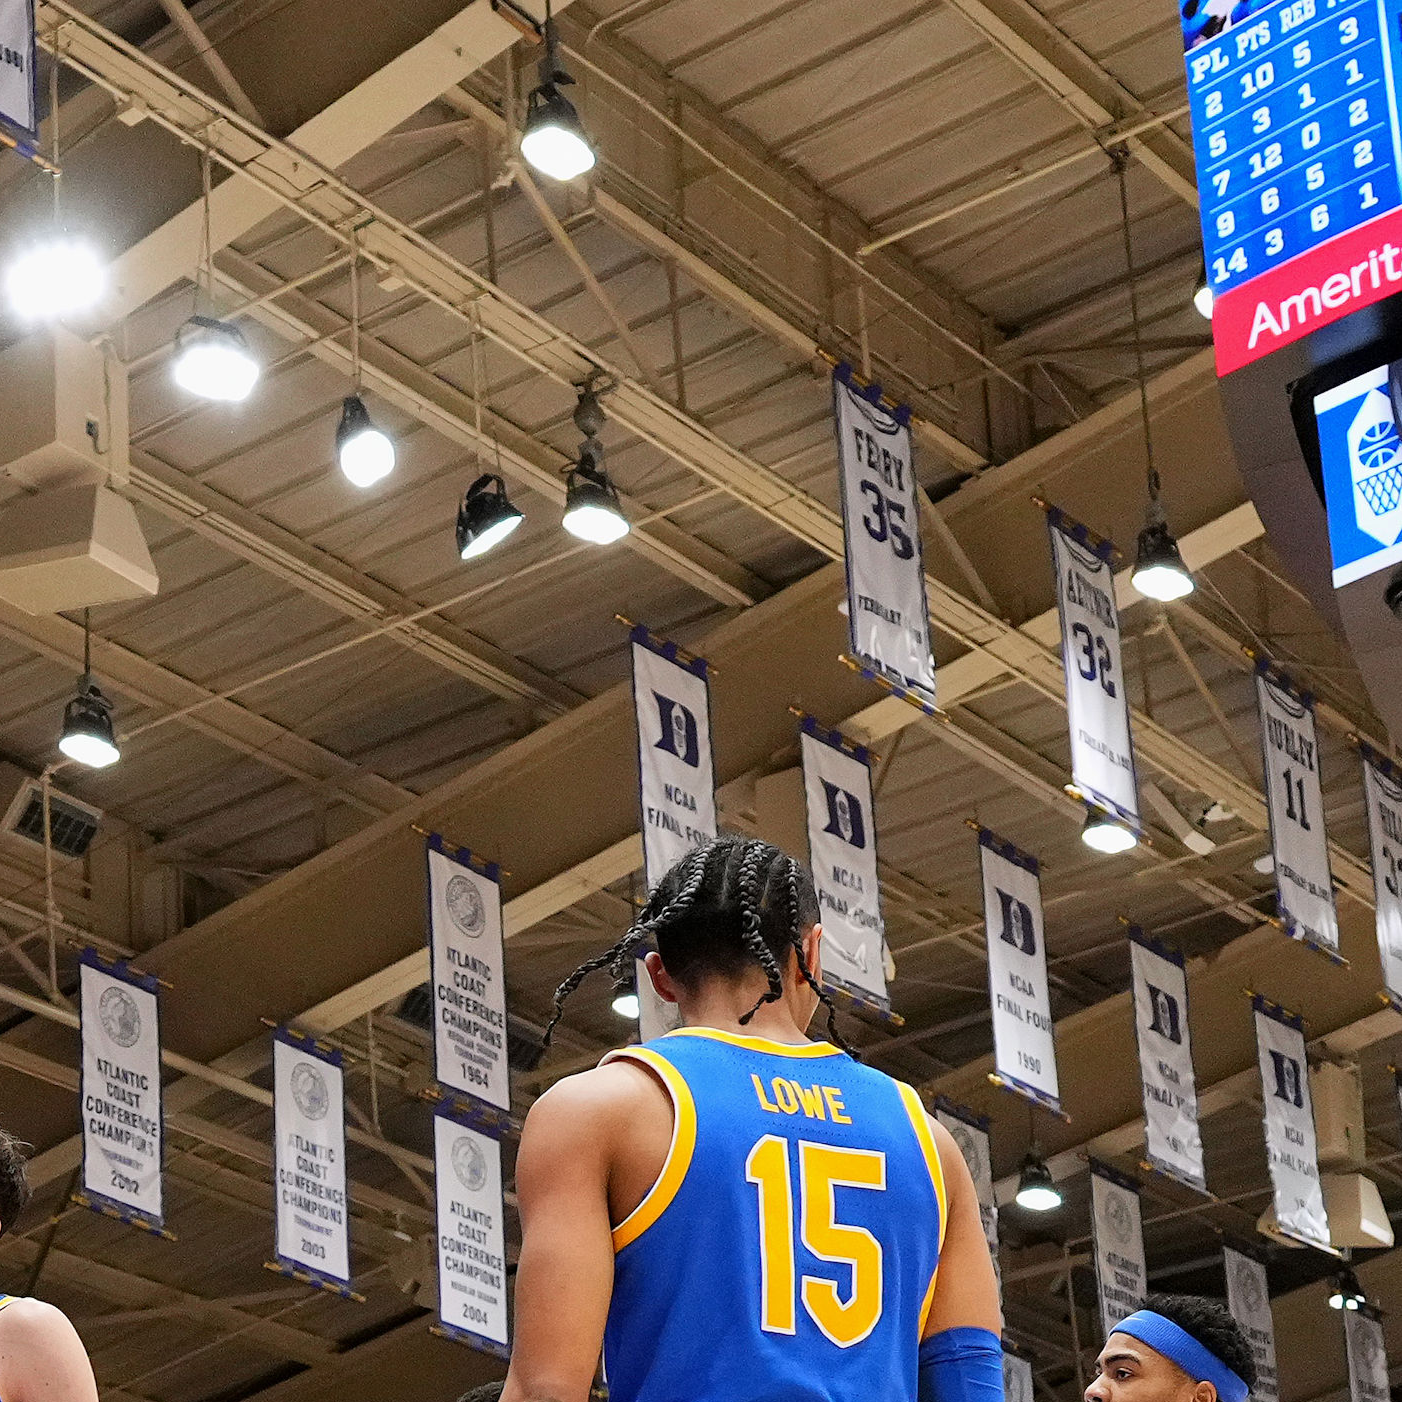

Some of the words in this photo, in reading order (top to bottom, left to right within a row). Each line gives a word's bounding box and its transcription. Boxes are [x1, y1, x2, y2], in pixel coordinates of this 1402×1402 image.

[1190, 47, 1230, 84] PL
[1235, 20, 1270, 59] PTS
[1279, 0, 1316, 34] REB
[1204, 90, 1223, 119] 2
[1239, 61, 1275, 99] 10
[1292, 40, 1312, 69] 5
[1339, 16, 1359, 45] 3
[1208, 131, 1227, 158] 5
[1251, 105, 1272, 135] 3
[1297, 82, 1316, 110] 1
[1345, 58, 1364, 86] 1
[1211, 168, 1231, 198] 7
[1248, 142, 1284, 180] 12
[1300, 121, 1322, 150] 0
[1348, 98, 1370, 128] 2
[1215, 210, 1236, 239] 9
[1260, 186, 1281, 216] 6
[1304, 162, 1326, 191] 5
[1352, 139, 1374, 169] 2
[1211, 247, 1249, 285] 14
[1264, 227, 1285, 257] 3
[1309, 203, 1331, 232] 6
[1357, 181, 1379, 210] 1
[1247, 243, 1402, 350] Amerit
[860, 479, 914, 560] 35
[1072, 621, 1116, 699] 32
[664, 783, 697, 814] NCAA
[1283, 768, 1311, 831] 11
[647, 807, 683, 838] FINAL
[832, 865, 864, 894] NCAA
[446, 946, 493, 982] ATLANTIC
[438, 984, 504, 1029] CONFERENCE
[997, 993, 1023, 1022] FINAL
[97, 1057, 148, 1091] ATLANTIC
[106, 1082, 141, 1109] COAST
[751, 1074, 852, 1124] LOWE
[86, 1095, 157, 1138] CONFERENCE
[89, 1118, 154, 1157] CHAMPIONS
[288, 1133, 334, 1163] ATLANTIC
[297, 1155, 328, 1180] COAST
[279, 1168, 344, 1207] CONFERENCE
[282, 1189, 342, 1225] CHAMPIONS
[450, 1200, 493, 1230] ATLANTIC
[458, 1222, 487, 1245] COAST
[441, 1236, 503, 1272] CONFERENCE
[745, 1133, 886, 1348] 15
[445, 1256, 501, 1290] CHAMPIONS
